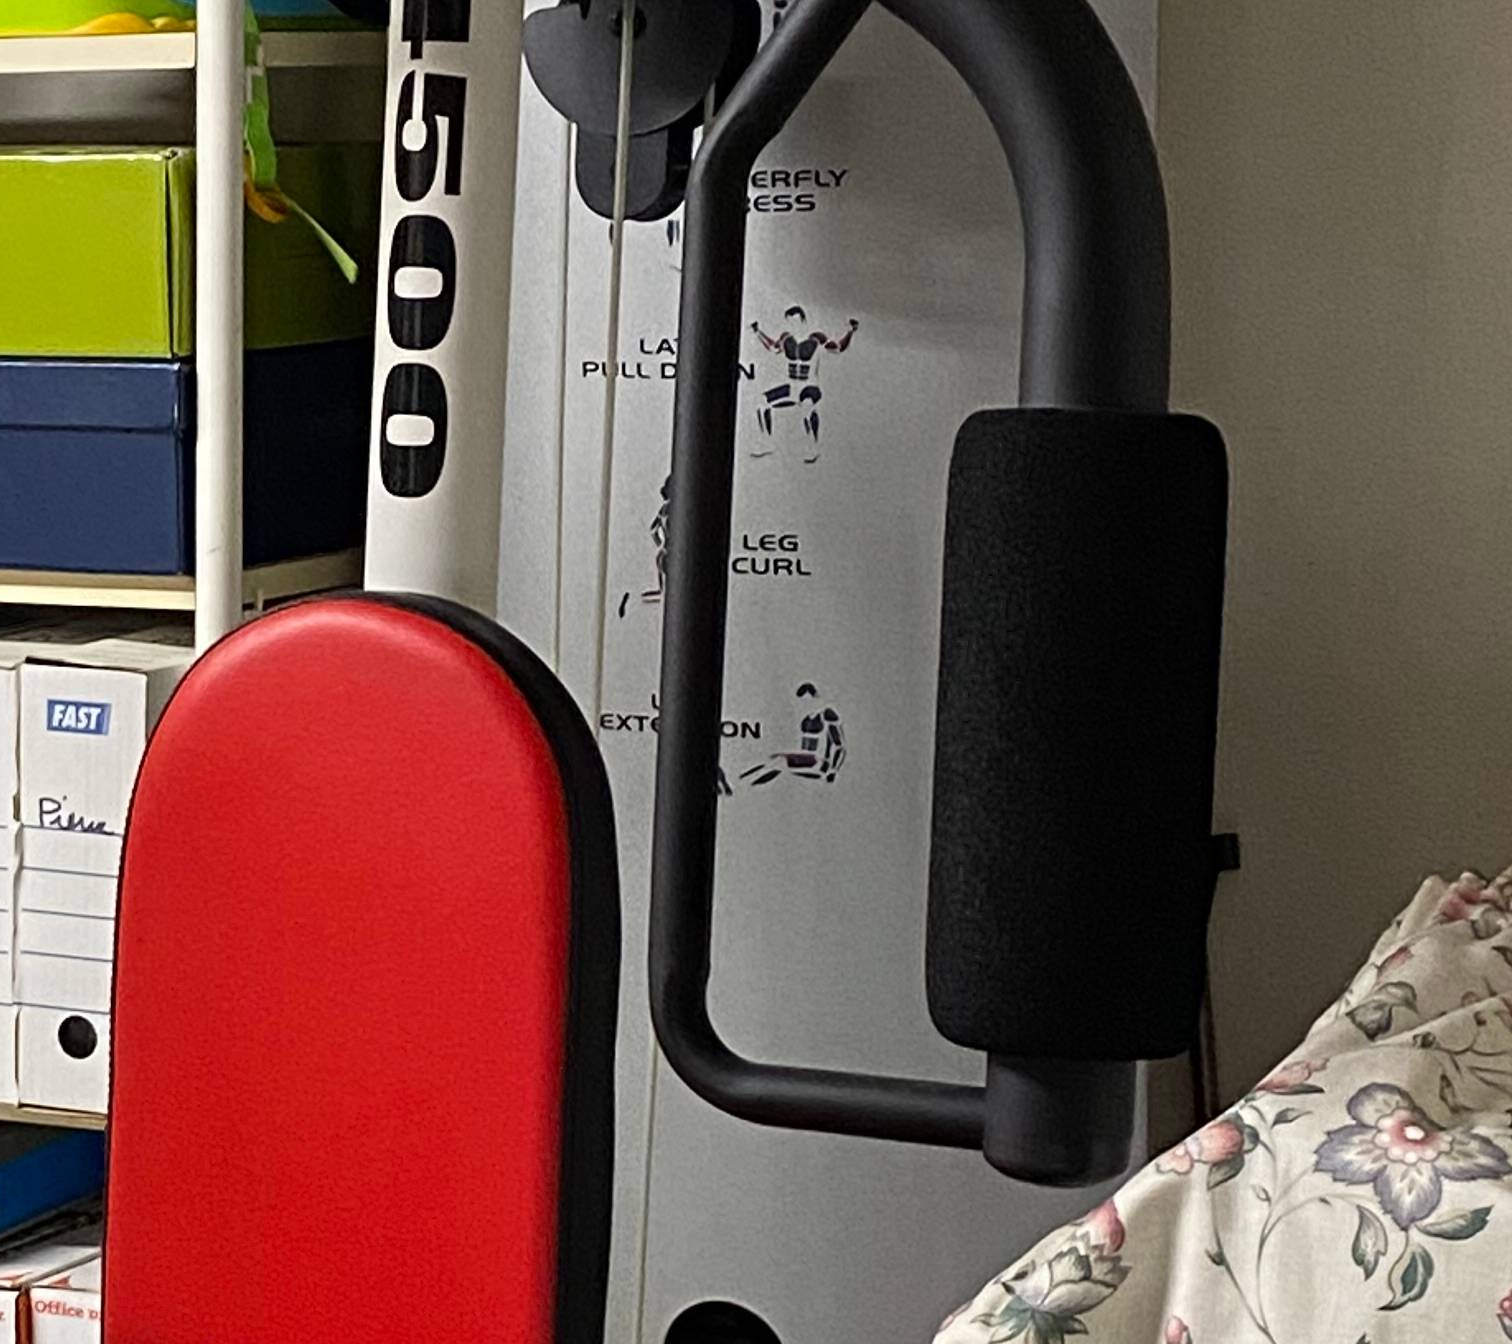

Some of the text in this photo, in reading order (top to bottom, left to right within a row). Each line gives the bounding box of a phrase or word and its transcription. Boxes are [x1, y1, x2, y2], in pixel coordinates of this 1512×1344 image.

[751, 169, 849, 189] ERFLY
[748, 194, 817, 212] ESS
[639, 338, 678, 356] LA
[743, 534, 799, 553] LEG
[731, 557, 812, 576] CURL
[51, 704, 102, 730] FAST
[35, 1300, 85, 1319] Office
